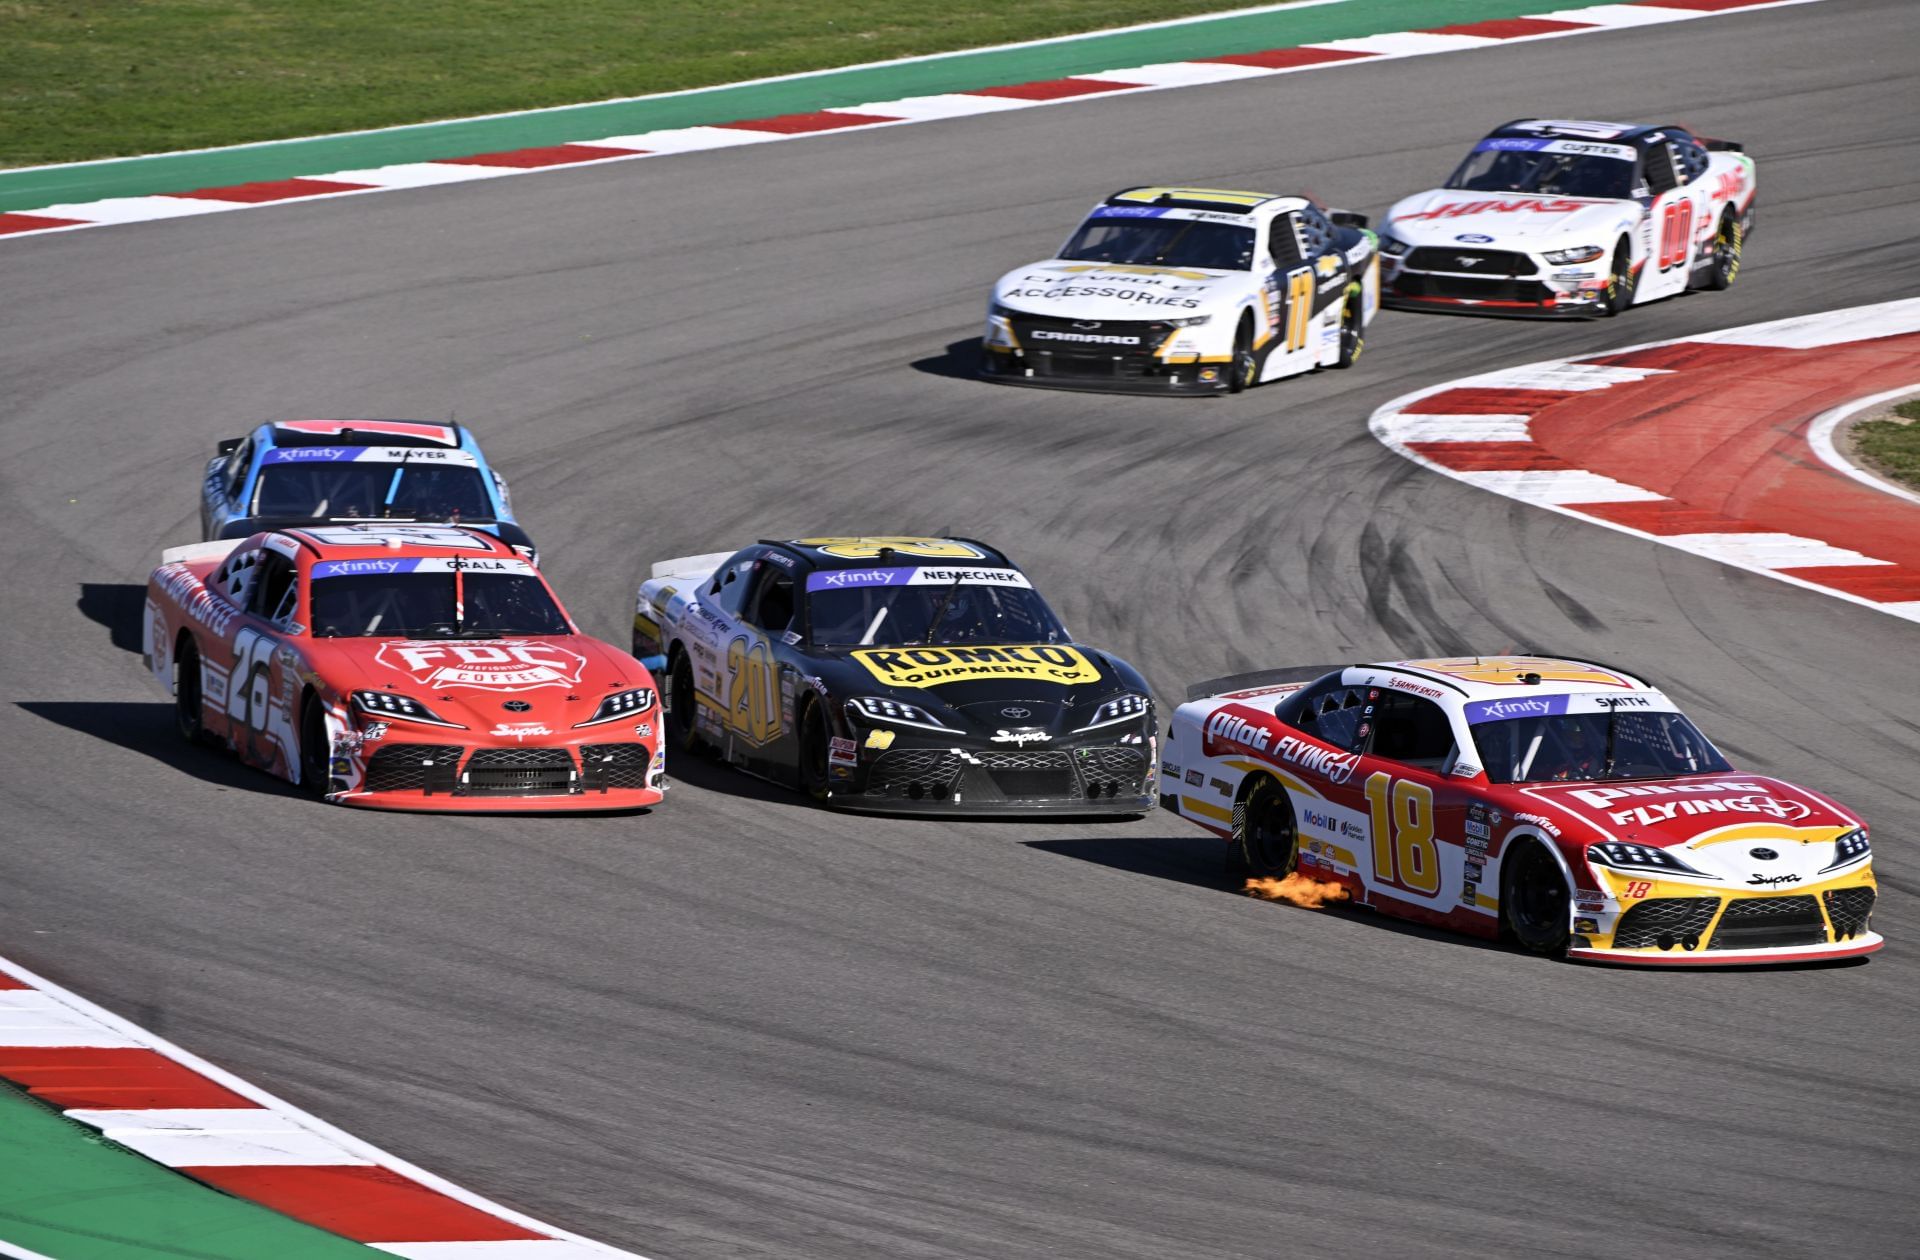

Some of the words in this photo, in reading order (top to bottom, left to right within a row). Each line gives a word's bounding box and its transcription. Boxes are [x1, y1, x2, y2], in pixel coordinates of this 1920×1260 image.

[1562, 143, 1620, 155] CUSTER
[1394, 199, 1614, 220] HAAS
[1004, 286, 1200, 309] ACCESSORIES
[1031, 330, 1141, 345] CAMARO
[278, 447, 343, 461] xfinity
[388, 450, 447, 460] MAYER
[328, 559, 400, 575] xfinity
[825, 571, 895, 586] xfinity
[923, 570, 1018, 582] NEMECHEK
[393, 647, 567, 671] FDC
[456, 663, 530, 671] FIREFIGHTERS
[864, 646, 1078, 673] ROMCO
[227, 626, 280, 732] 26
[456, 672, 544, 683] COFFEE
[889, 665, 1037, 683] EQUIPMENT
[728, 634, 783, 748] 20
[1396, 680, 1421, 693] SAMMY
[1418, 686, 1445, 699] SMITH
[1482, 698, 1550, 719] xfinity
[1595, 696, 1650, 709] SMITH
[489, 723, 553, 742] Supra
[990, 729, 1053, 748] Supra
[1273, 735, 1338, 776] FLYING
[1304, 809, 1328, 829] Mobil
[1608, 798, 1761, 826] FLYING
[1365, 770, 1440, 898] 18
[1466, 820, 1483, 835] Mobil
[1514, 812, 1561, 838] GOODYEAR
[1624, 881, 1653, 899] 18
[1746, 873, 1802, 890] Supra
